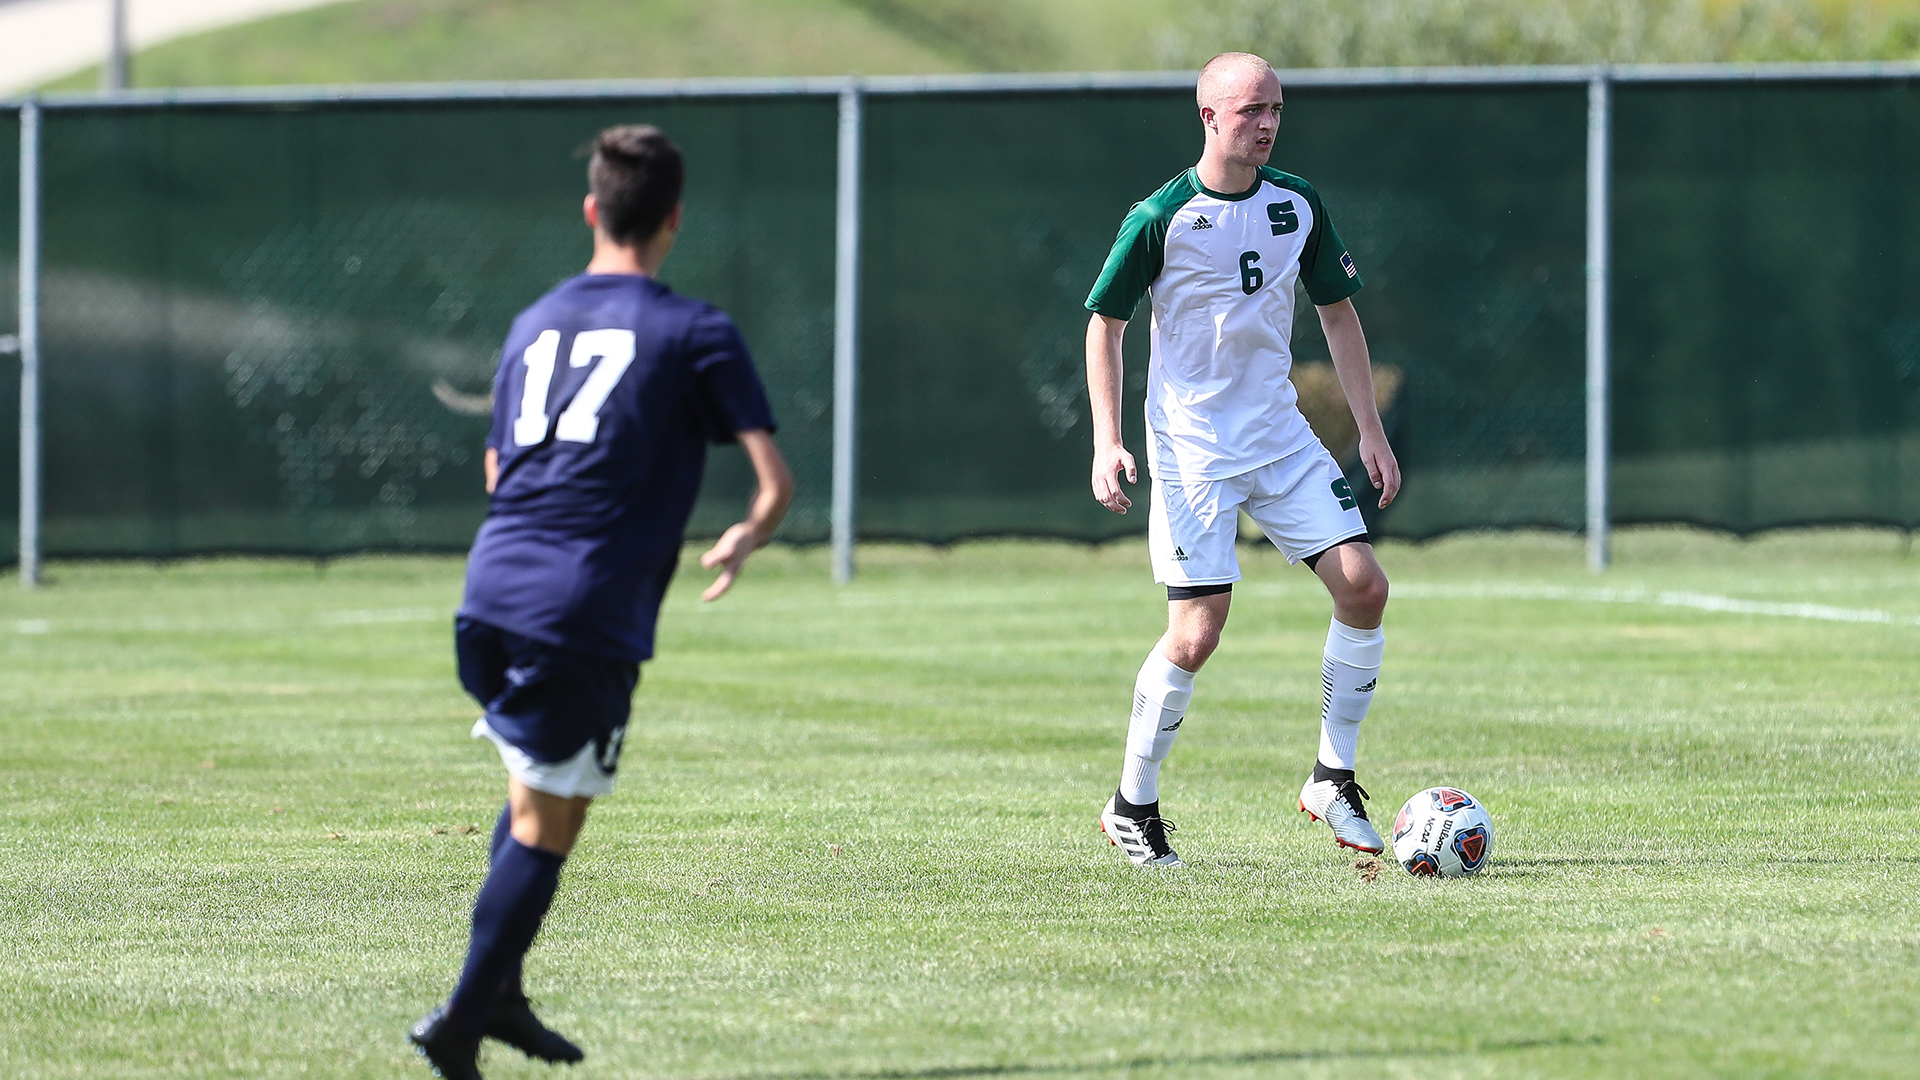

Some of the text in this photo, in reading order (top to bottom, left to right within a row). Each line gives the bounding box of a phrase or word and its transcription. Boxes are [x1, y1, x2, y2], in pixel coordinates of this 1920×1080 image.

[1191, 223, 1213, 231] adidas
[1266, 199, 1299, 236] S
[1239, 250, 1263, 295] 6
[514, 328, 636, 447] 17
[1421, 816, 1435, 843] NCAA
[1434, 820, 1453, 852] Wilson
